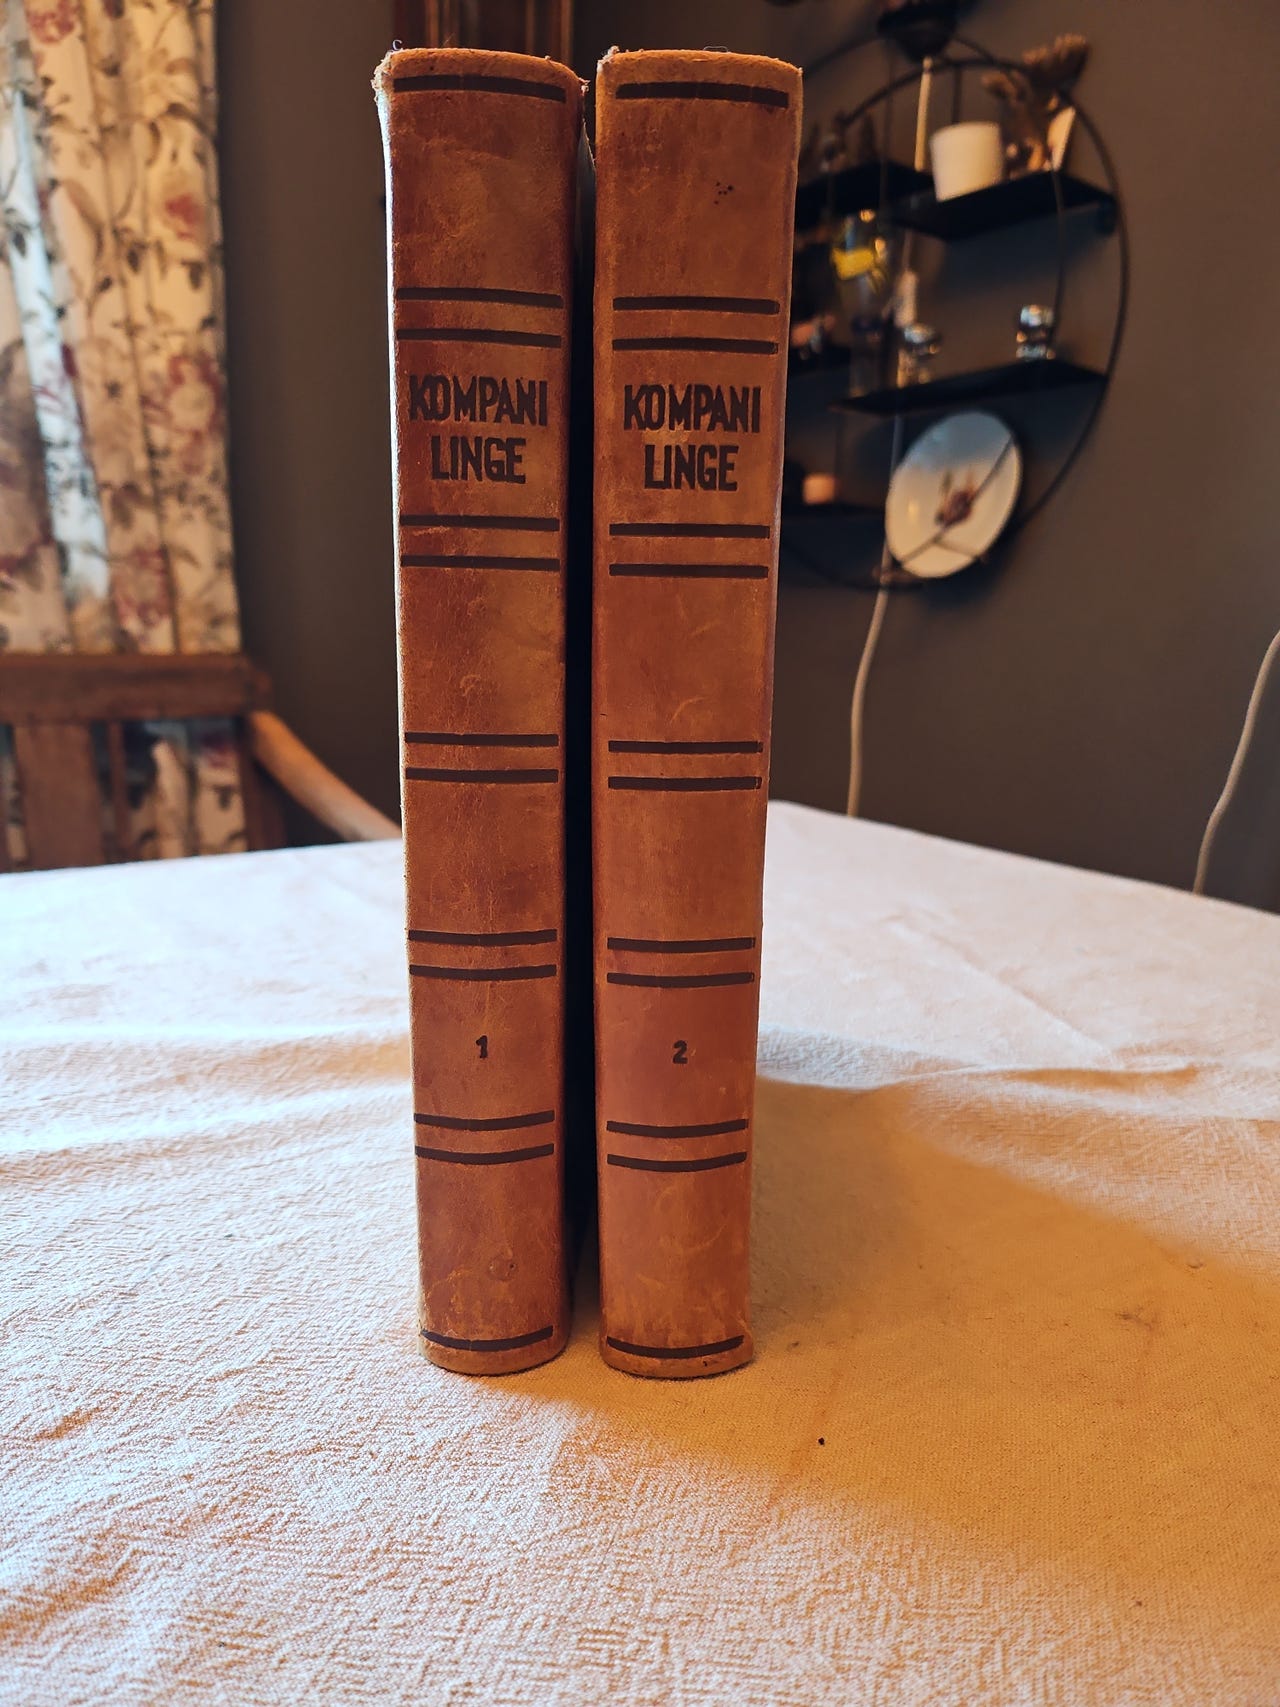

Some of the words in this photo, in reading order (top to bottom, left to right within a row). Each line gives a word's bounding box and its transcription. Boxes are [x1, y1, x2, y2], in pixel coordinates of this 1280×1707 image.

[409, 374, 548, 427] KOMPANI
[623, 383, 761, 434] KOMPANI
[430, 435, 526, 484] LINGE
[644, 444, 739, 492] LINGE
[475, 1035, 489, 1059] 1
[672, 1040, 688, 1064] 2
